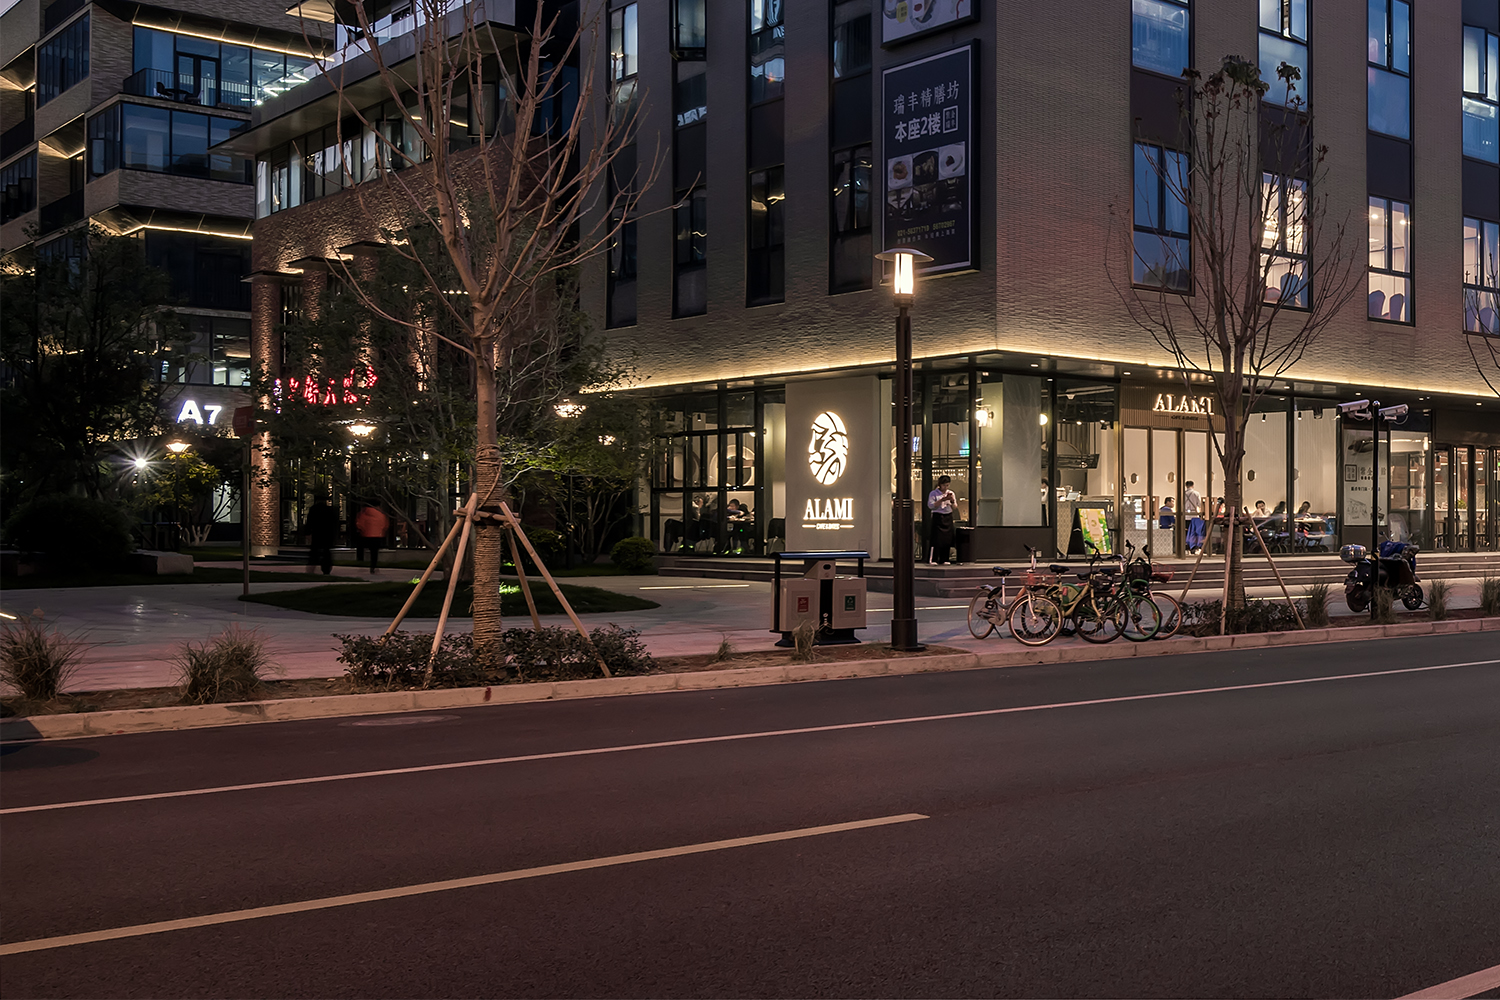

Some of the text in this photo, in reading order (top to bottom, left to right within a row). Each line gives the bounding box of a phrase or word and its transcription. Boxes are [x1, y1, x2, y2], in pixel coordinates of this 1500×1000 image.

[893, 79, 961, 116] 瑞丰精膳坊
[894, 111, 941, 143] 本座2楼
[176, 400, 223, 425] A7
[1152, 393, 1215, 415] ALAMI
[803, 497, 854, 521] ALAMI
